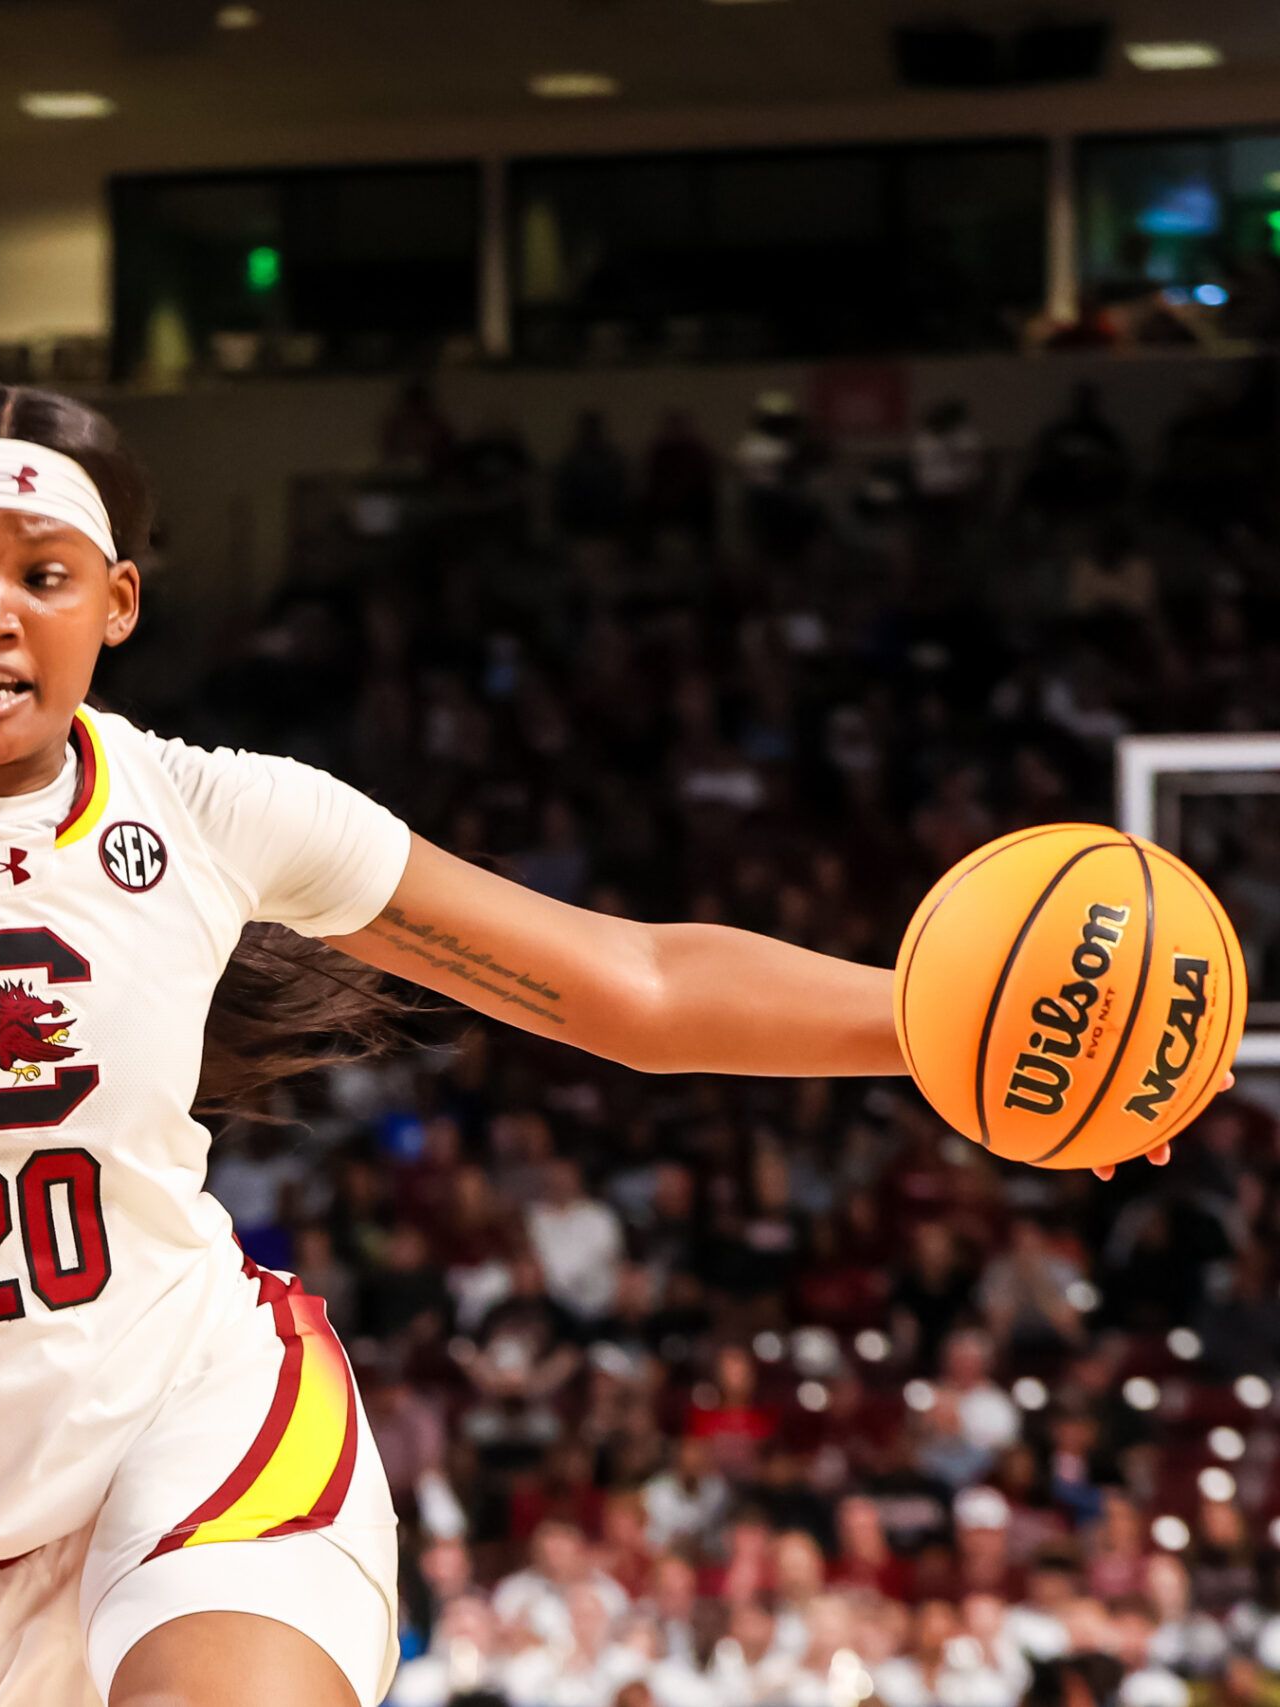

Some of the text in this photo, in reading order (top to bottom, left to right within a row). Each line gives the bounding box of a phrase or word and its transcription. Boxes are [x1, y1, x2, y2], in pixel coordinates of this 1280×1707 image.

[104, 824, 162, 887] SEC
[1003, 902, 1129, 1116] Wilson
[1086, 986, 1116, 1060] EVO NXT
[1123, 953, 1210, 1123] NCAA
